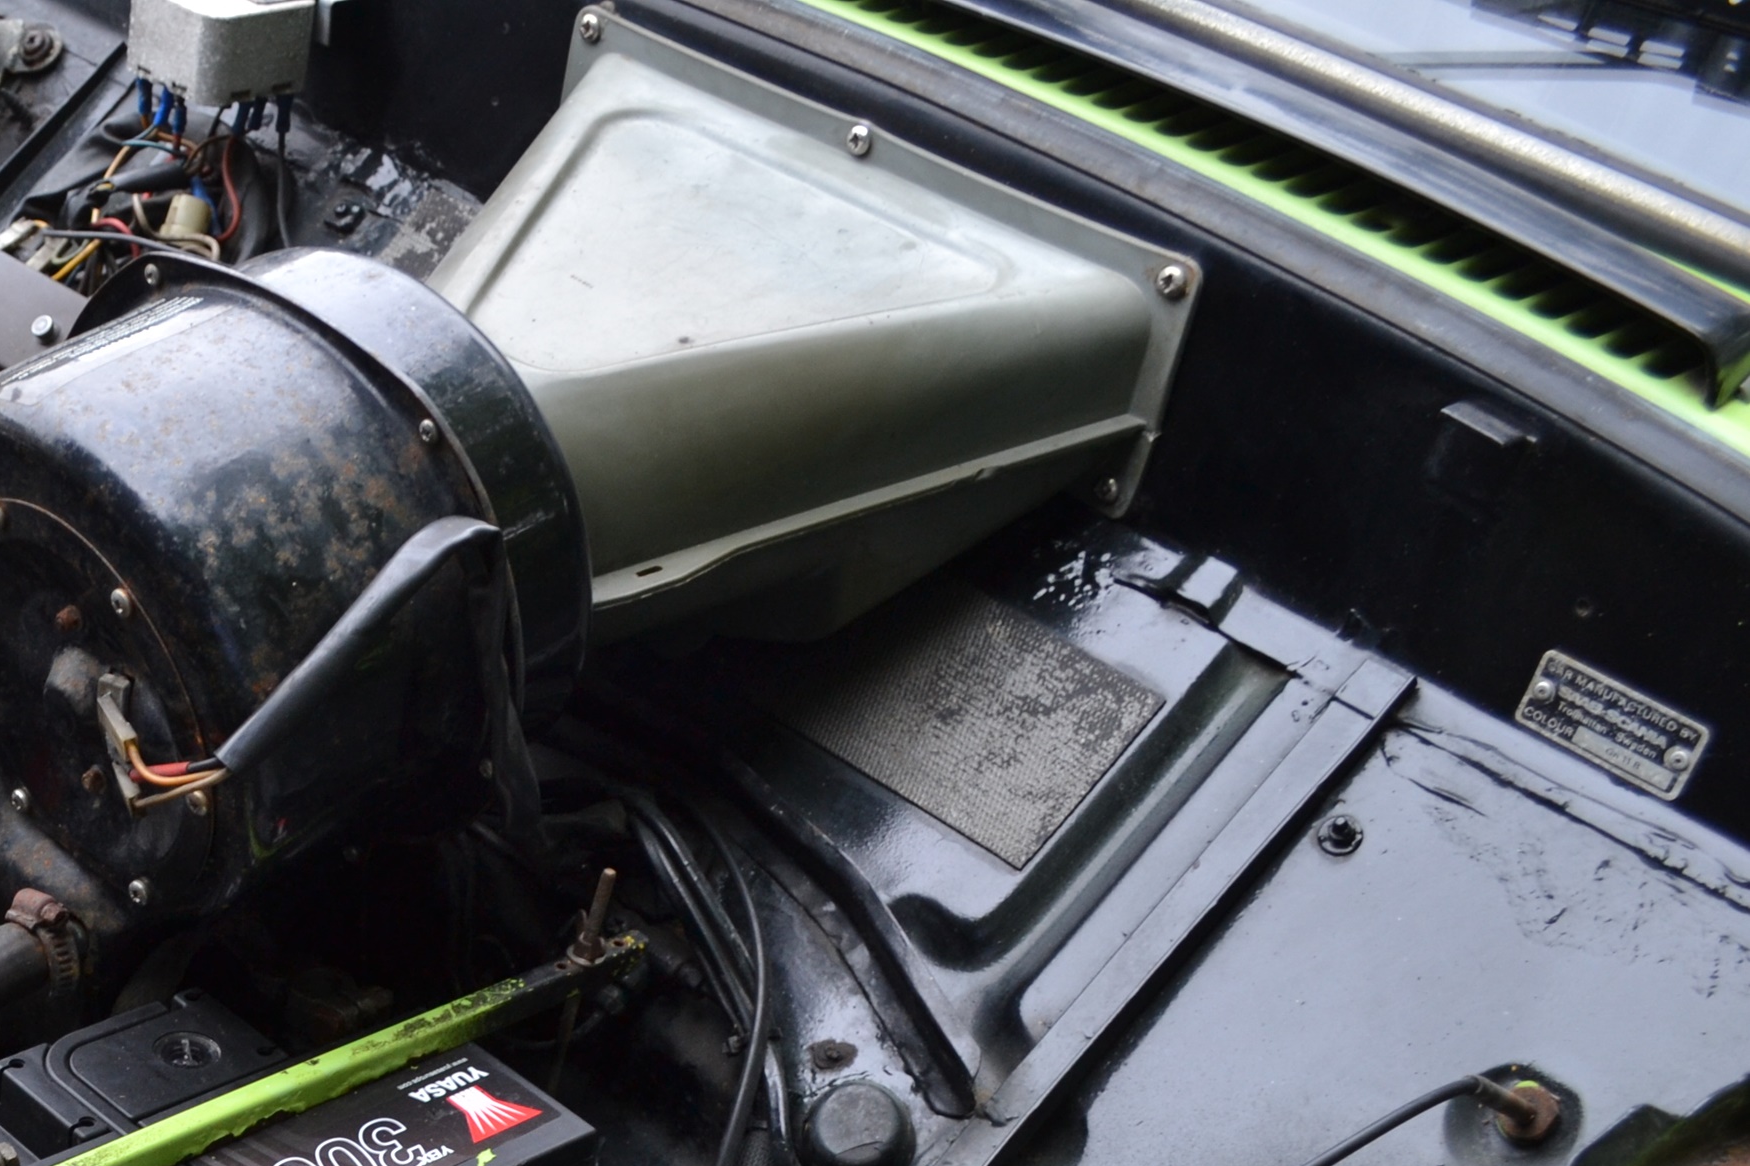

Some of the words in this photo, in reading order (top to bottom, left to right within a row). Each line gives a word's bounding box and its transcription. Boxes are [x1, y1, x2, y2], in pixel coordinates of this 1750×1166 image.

[1521, 703, 1575, 739] COLOUR
[1572, 672, 1679, 735] MANUFACTURED
[408, 1065, 489, 1103] YUASA
